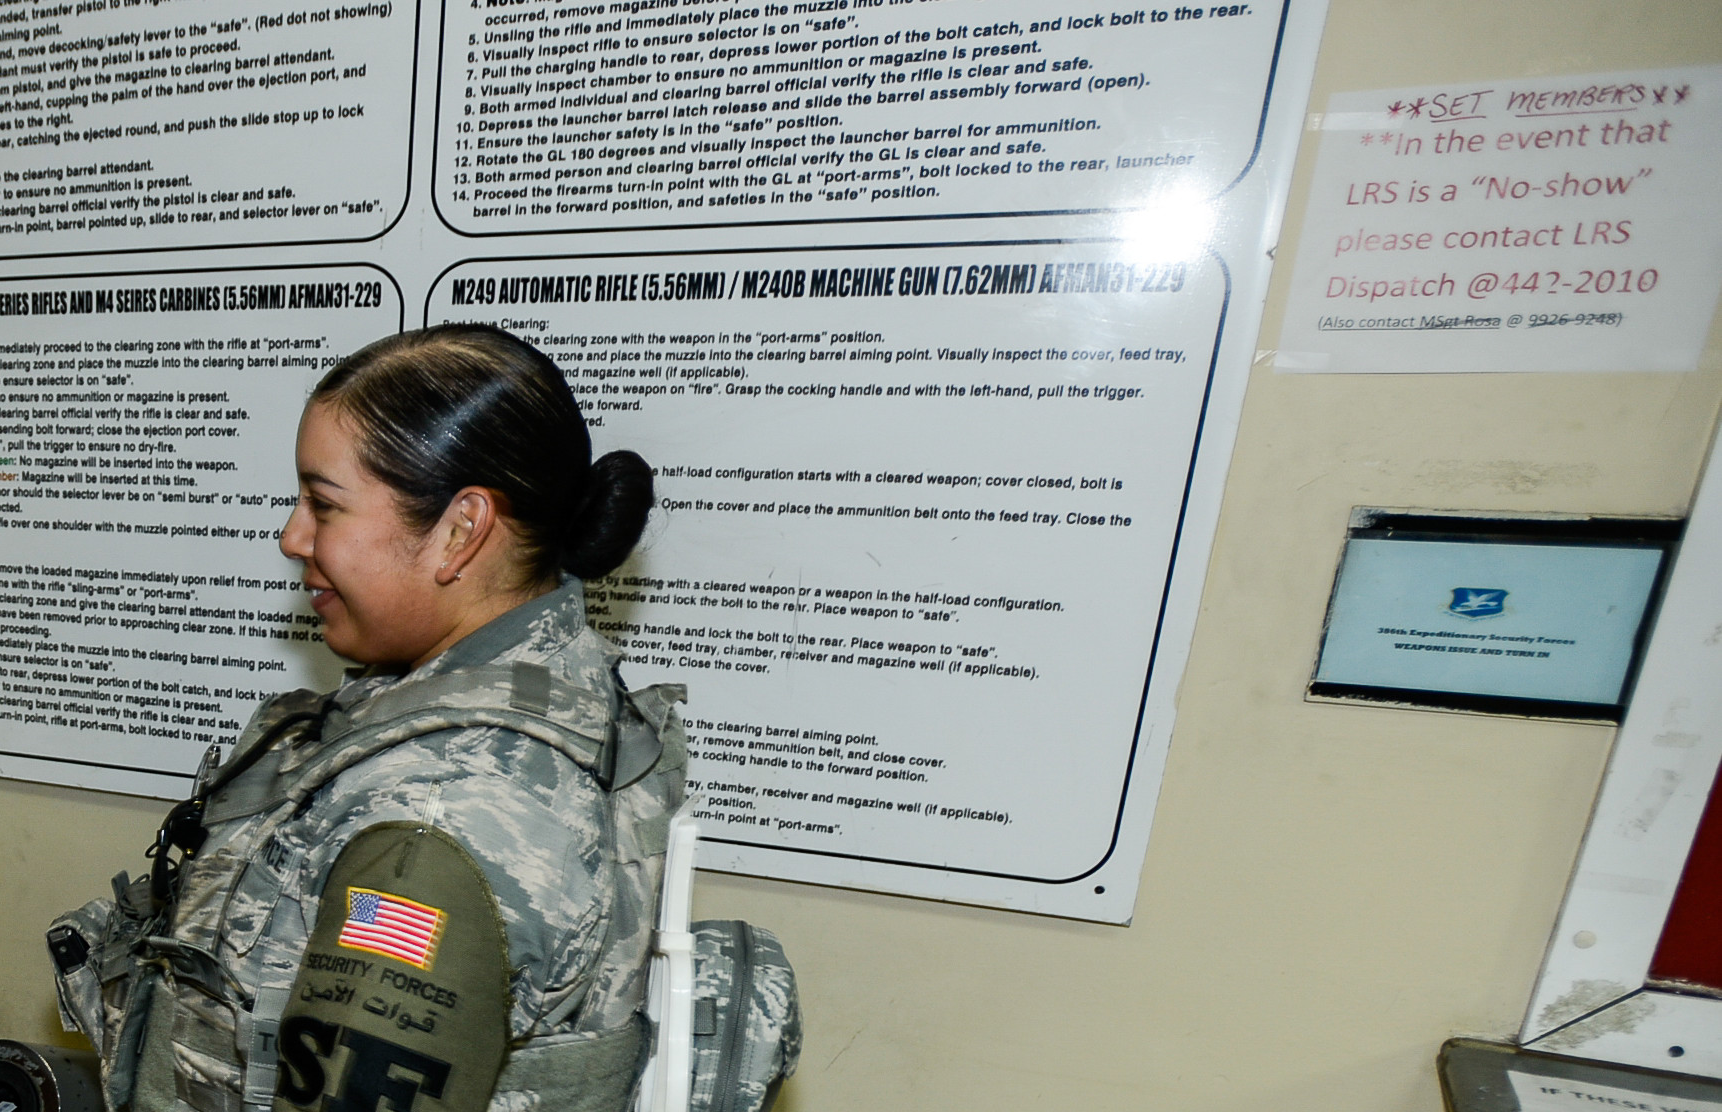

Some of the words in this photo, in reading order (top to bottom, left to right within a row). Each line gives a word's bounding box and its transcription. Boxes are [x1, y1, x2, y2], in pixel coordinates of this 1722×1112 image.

[286, 10, 307, 26] dot
[309, 7, 330, 23] not
[333, 0, 392, 20] showing)
[173, 25, 186, 39] to
[188, 22, 207, 37] the
[209, 16, 251, 34] “safe”.
[254, 12, 283, 32] (Red
[47, 33, 141, 54] move
[48, 30, 141, 54] decocking/safety
[142, 28, 172, 42] lever
[456, 120, 474, 134] 10.
[478, 118, 533, 134] Depress
[536, 114, 559, 128] the
[561, 110, 623, 126] launcher
[626, 105, 669, 121] barrel
[672, 103, 708, 118] latch
[712, 98, 767, 115] release
[771, 95, 801, 111] and
[804, 93, 842, 109] slide
[846, 90, 872, 106] the
[876, 87, 925, 104] barrel
[928, 81, 1010, 100] assembly
[1014, 76, 1082, 95] forward
[1087, 71, 1150, 93] (open).
[1434, 129, 1485, 154] the
[1496, 127, 1589, 151] event
[1600, 118, 1672, 144] that
[1346, 181, 1399, 206] LRS
[1408, 180, 1430, 203] is
[1439, 183, 1457, 202] a
[1471, 167, 1653, 201] “No-show”
[1335, 228, 1432, 258] please
[1444, 223, 1563, 250] contact
[1572, 220, 1632, 246] LRS
[452, 276, 496, 306] M249
[497, 273, 592, 304] AUTOMATIC
[594, 273, 638, 302] RIFLE
[740, 268, 806, 299] M240B
[808, 266, 896, 298] MACHINE
[897, 265, 940, 297] GUN
[1326, 272, 1455, 302] Dispatch
[30, 290, 67, 316] RIFLES
[68, 289, 93, 315] AND
[94, 288, 114, 314] M4
[115, 287, 157, 314] SEIRES
[158, 284, 220, 313] CARBINES
[287, 280, 382, 310] AFMAN31-229
[496, 317, 549, 333] Clearing:
[1358, 315, 1415, 328] contact
[1506, 315, 1524, 328] @
[1, 376, 34, 387] ensure
[35, 373, 74, 386] selector
[75, 373, 84, 386] is
[85, 375, 99, 386] on
[100, 372, 134, 386] “safe”.
[18, 454, 32, 467] No
[33, 455, 78, 470] magazine
[79, 455, 96, 468] will
[98, 456, 111, 468] be
[112, 456, 153, 469] inserted
[154, 457, 174, 470] into
[175, 457, 193, 470] the
[194, 460, 238, 473] weapon.
[661, 498, 692, 515] Open
[694, 498, 714, 511] the
[715, 501, 750, 512] cover
[751, 500, 775, 513] and
[777, 501, 811, 516] place
[813, 502, 834, 515] the
[836, 504, 910, 518] ammunition
[913, 506, 938, 519] belt
[940, 508, 971, 520] onto
[973, 508, 995, 521] the
[998, 509, 1029, 523] feed
[1031, 511, 1061, 527] tray.
[1065, 511, 1106, 526] Close
[1109, 513, 1132, 527] the
[1377, 628, 1408, 636] 386th
[1409, 629, 1487, 641] Expeditionary
[1488, 633, 1535, 644] Security
[1536, 636, 1577, 645] Forces
[1394, 643, 1447, 652] WEAPONS
[1448, 646, 1477, 654] ISSUE
[1478, 648, 1503, 656] AND
[1505, 650, 1535, 658] TURN
[689, 809, 725, 821] urn-in
[726, 812, 757, 825] point
[758, 816, 770, 827] at
[772, 816, 842, 835] “port-arms”.
[306, 953, 375, 978] SECURITY
[380, 967, 458, 1008] FORCES
[1539, 1086, 1563, 1095] IF
[1568, 1090, 1654, 1112] THESE
